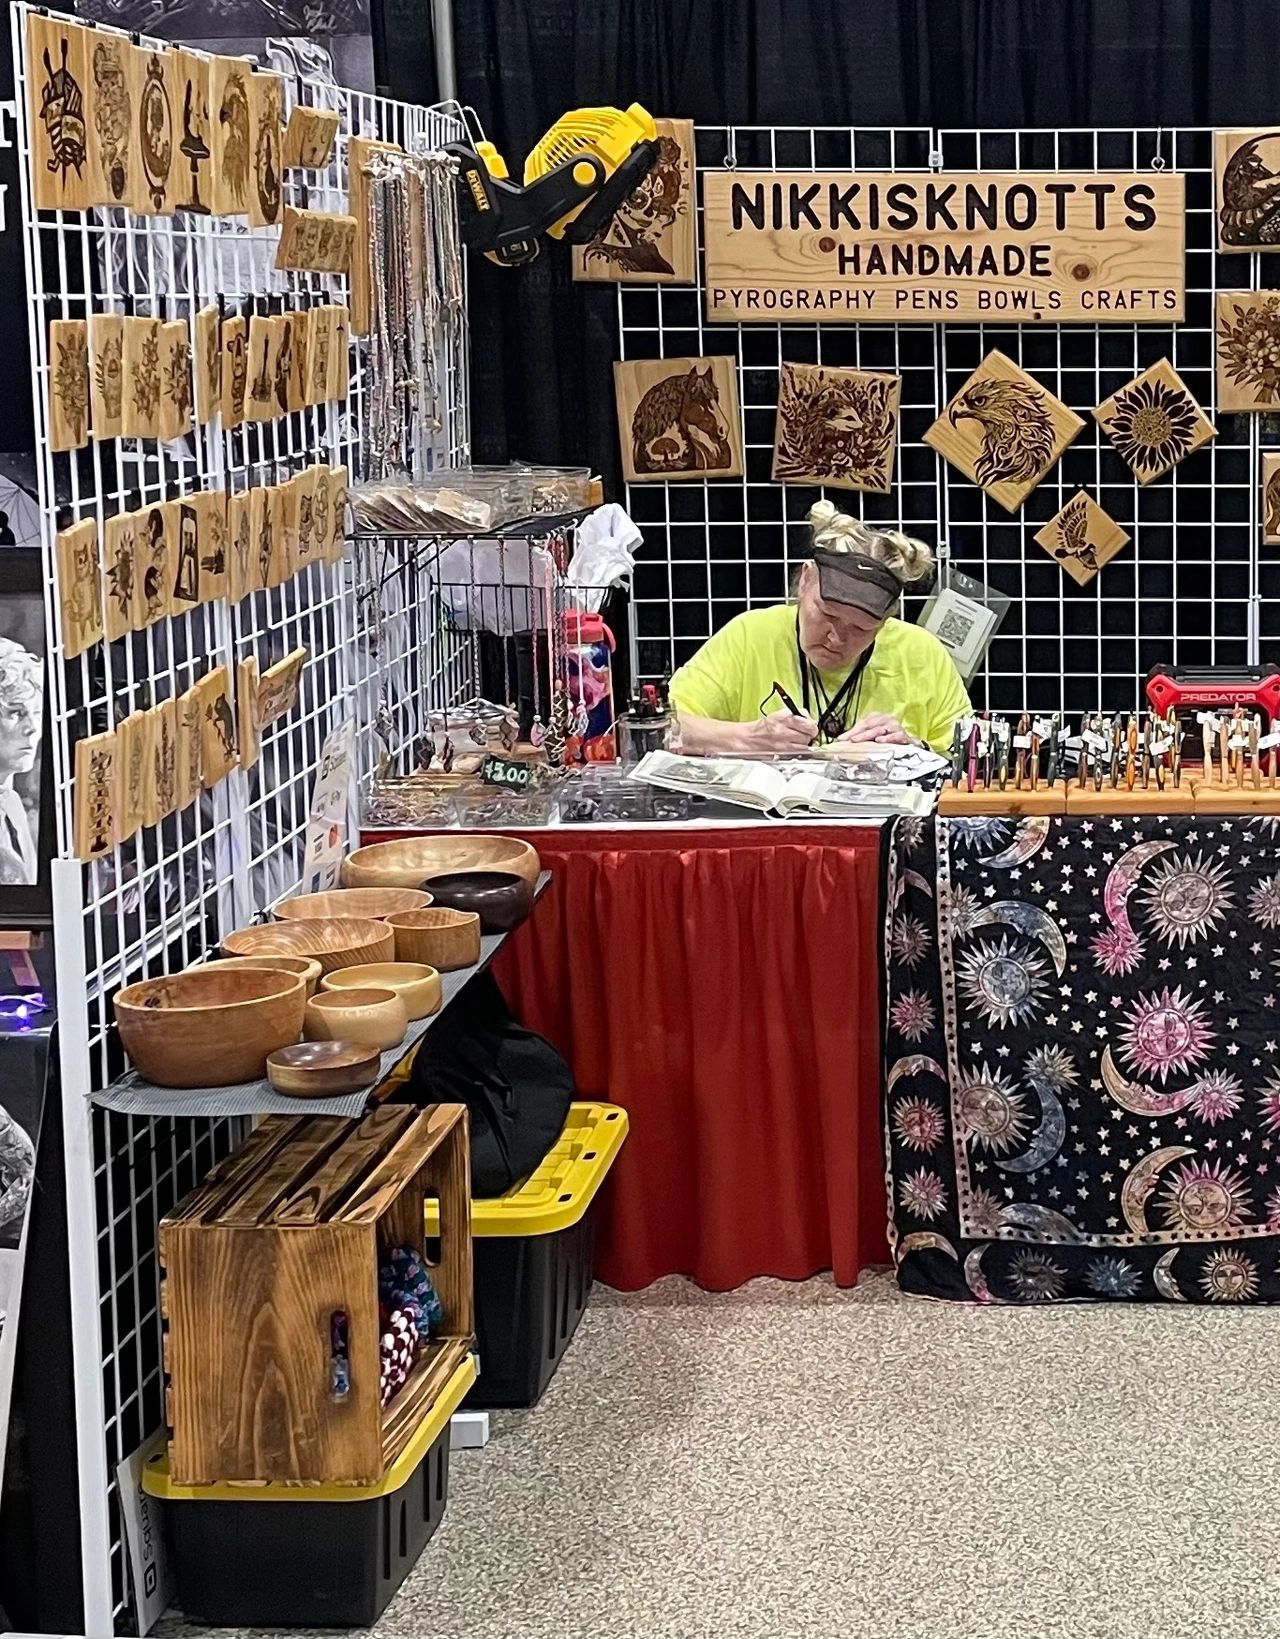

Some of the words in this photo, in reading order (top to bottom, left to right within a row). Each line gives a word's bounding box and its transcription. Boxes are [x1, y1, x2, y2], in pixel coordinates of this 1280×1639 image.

[731, 183, 1157, 232] NIKKISKNOTTS
[838, 244, 1052, 278] HANDMADE
[713, 288, 875, 311] PYROGRAPHY
[895, 288, 959, 311] PENS
[978, 288, 1062, 311] BOWLS
[1081, 288, 1178, 310] CRAFTS
[1180, 692, 1257, 702] PREDATOR
